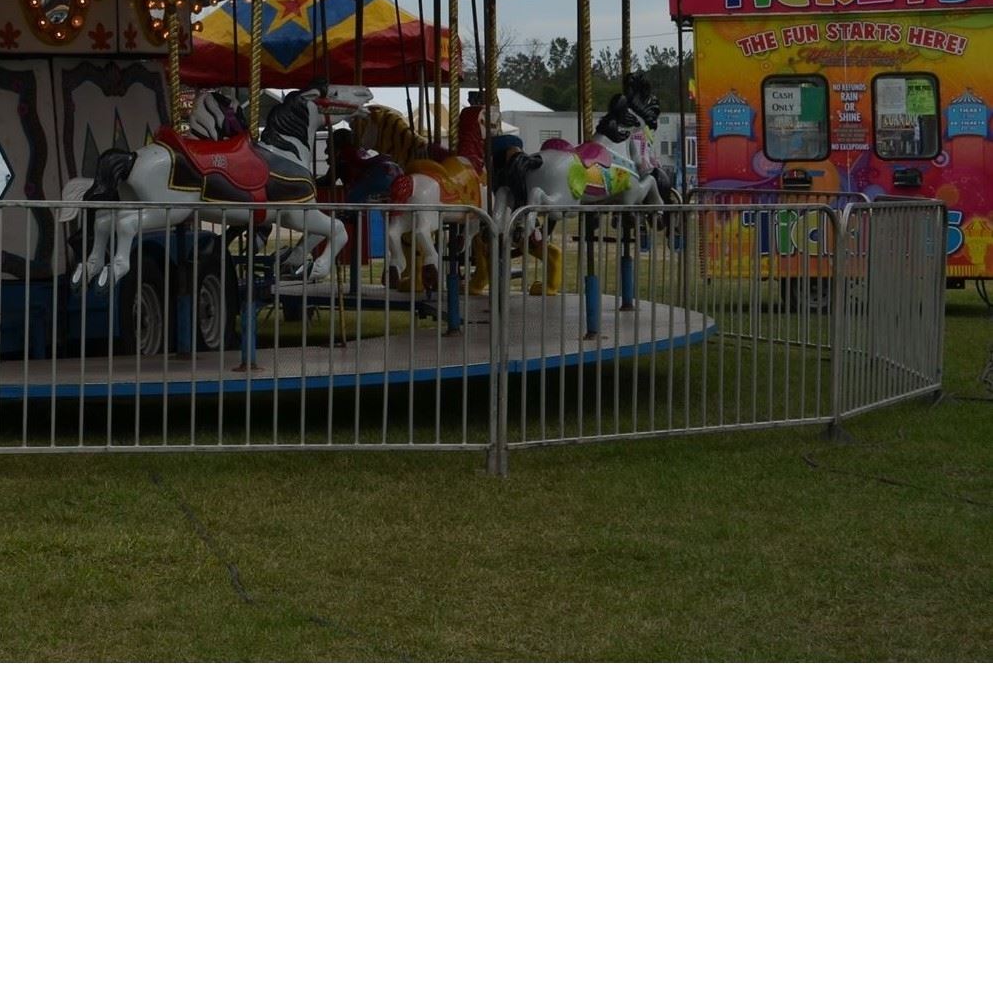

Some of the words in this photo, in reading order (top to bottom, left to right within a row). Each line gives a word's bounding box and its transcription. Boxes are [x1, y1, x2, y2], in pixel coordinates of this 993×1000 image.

[737, 30, 780, 57] THE
[782, 23, 820, 47] FUN
[825, 20, 902, 43] STARTS
[907, 26, 968, 56] HERE!
[840, 92, 859, 102] RAIN
[844, 102, 855, 112] OR
[838, 112, 862, 122] SHINE
